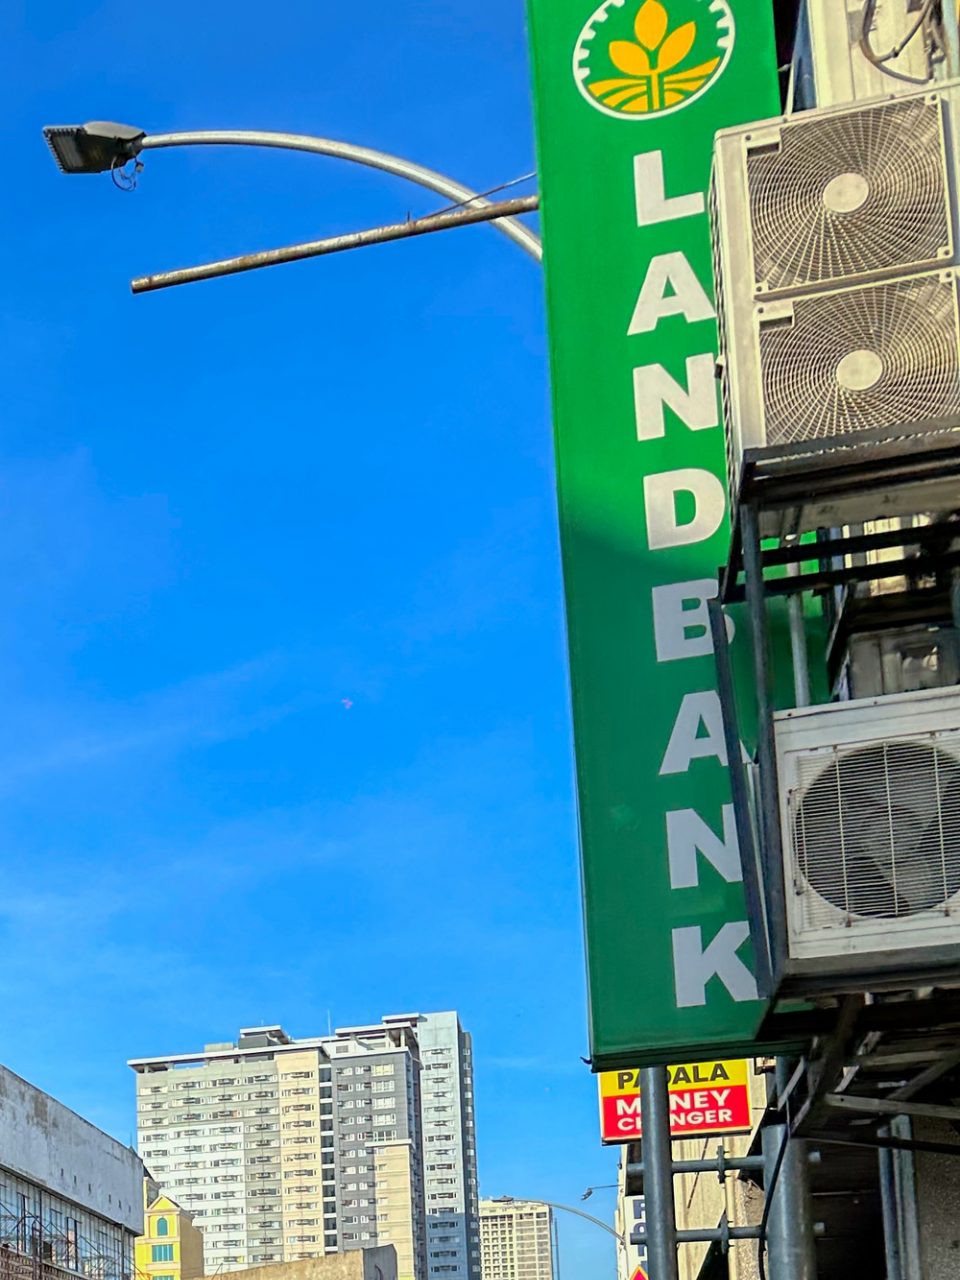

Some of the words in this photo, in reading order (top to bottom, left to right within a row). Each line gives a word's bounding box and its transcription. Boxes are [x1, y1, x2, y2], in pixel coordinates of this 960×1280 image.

[617, 1063, 730, 1090] PALA
[616, 1088, 731, 1116] MNEY
[617, 1108, 733, 1131] CNGER
